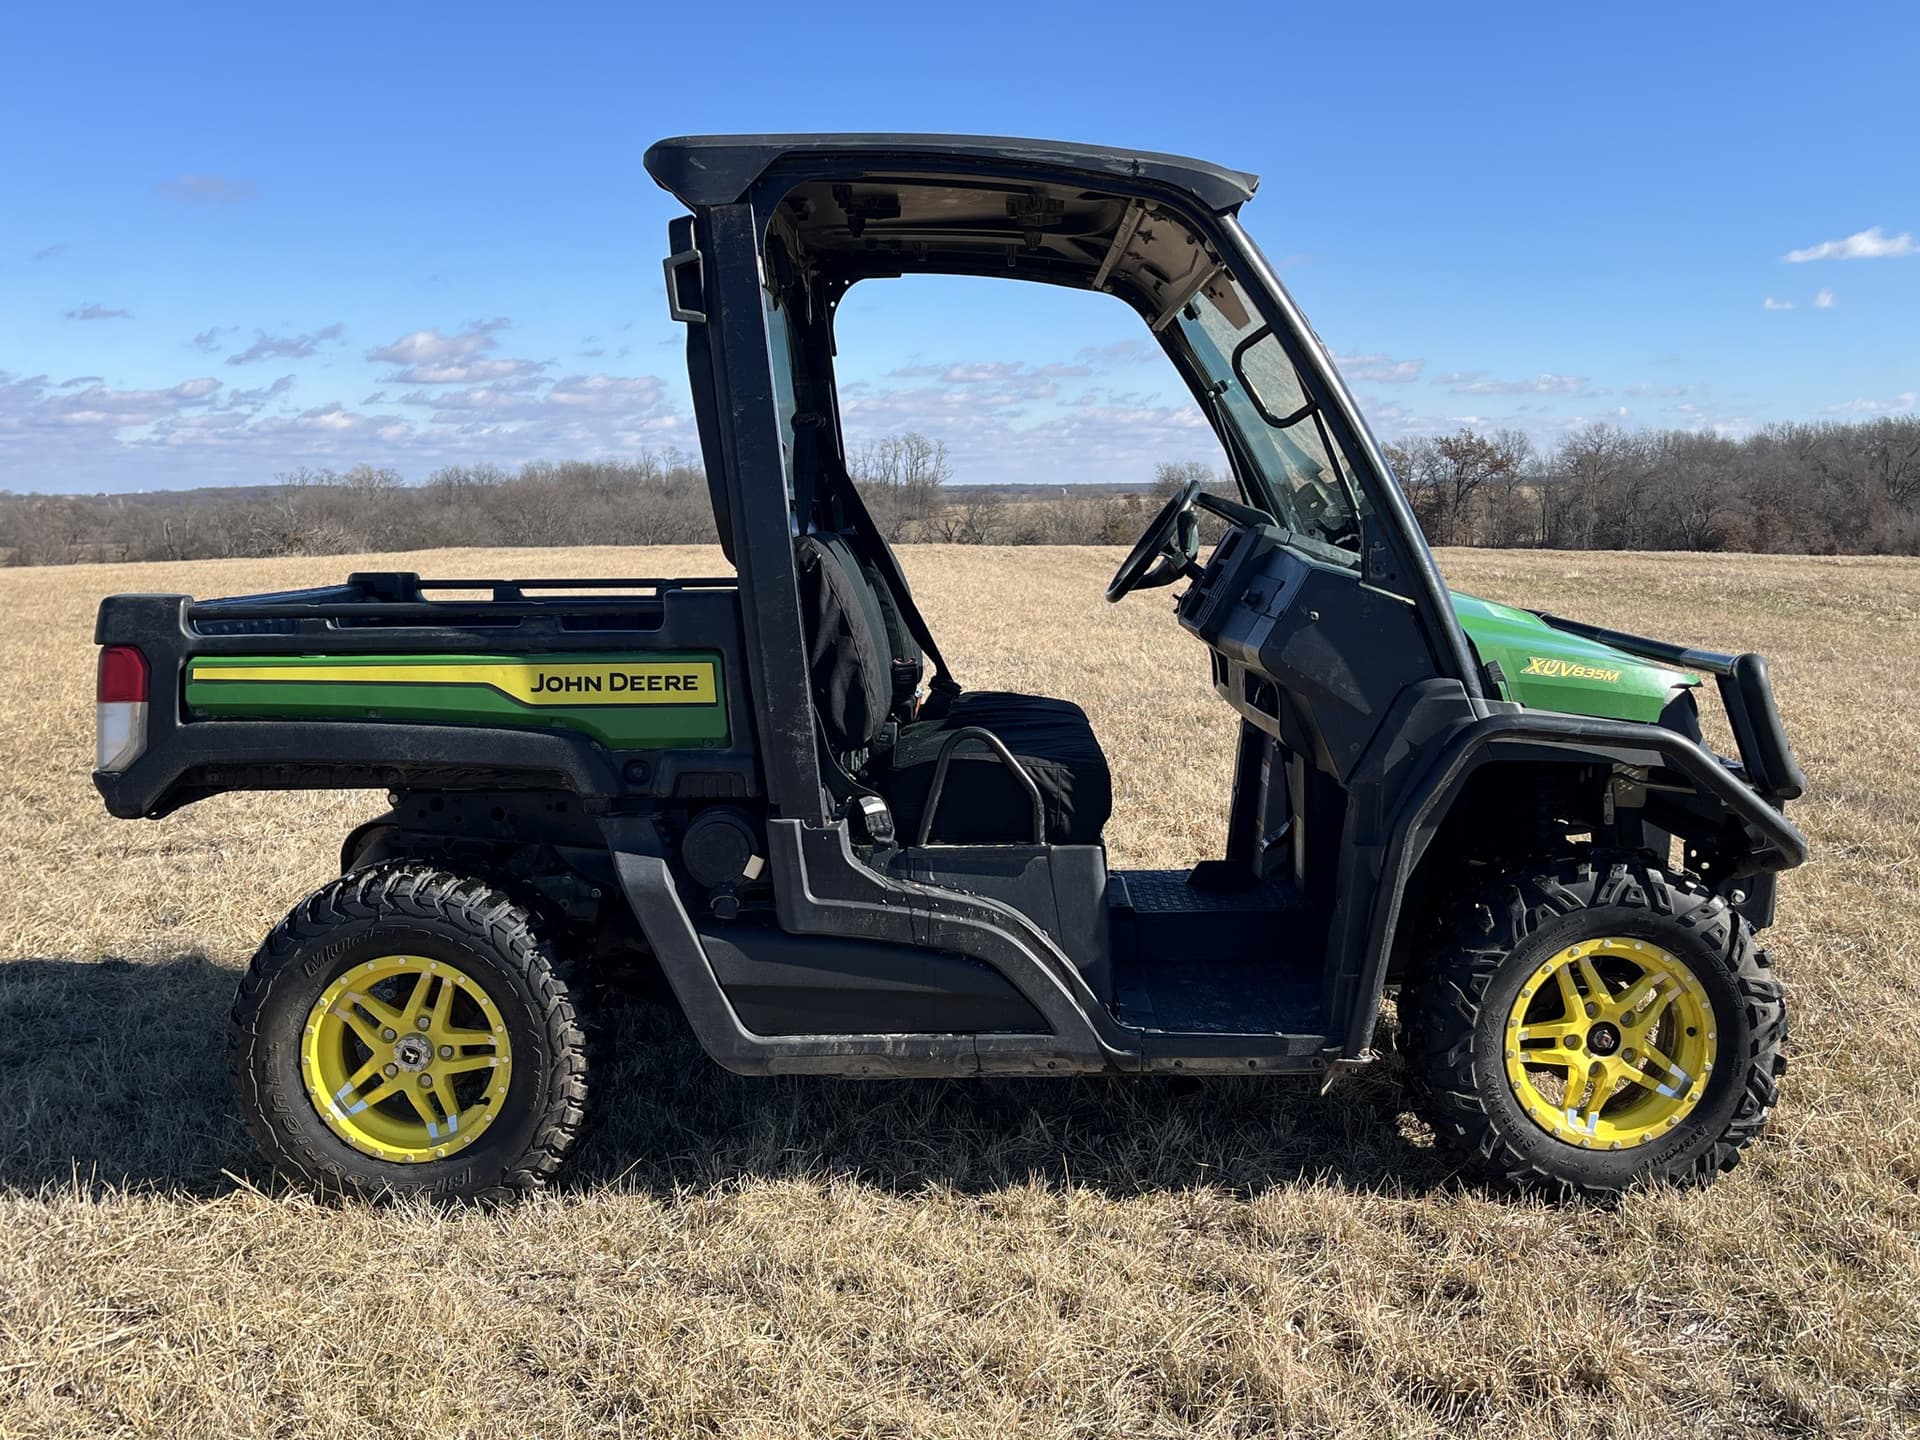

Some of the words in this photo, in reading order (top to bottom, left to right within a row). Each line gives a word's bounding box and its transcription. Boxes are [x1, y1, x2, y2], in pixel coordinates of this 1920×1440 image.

[1524, 657, 1621, 682] XUV835M
[531, 673, 602, 692] JOHN
[609, 672, 699, 691] DEERE
